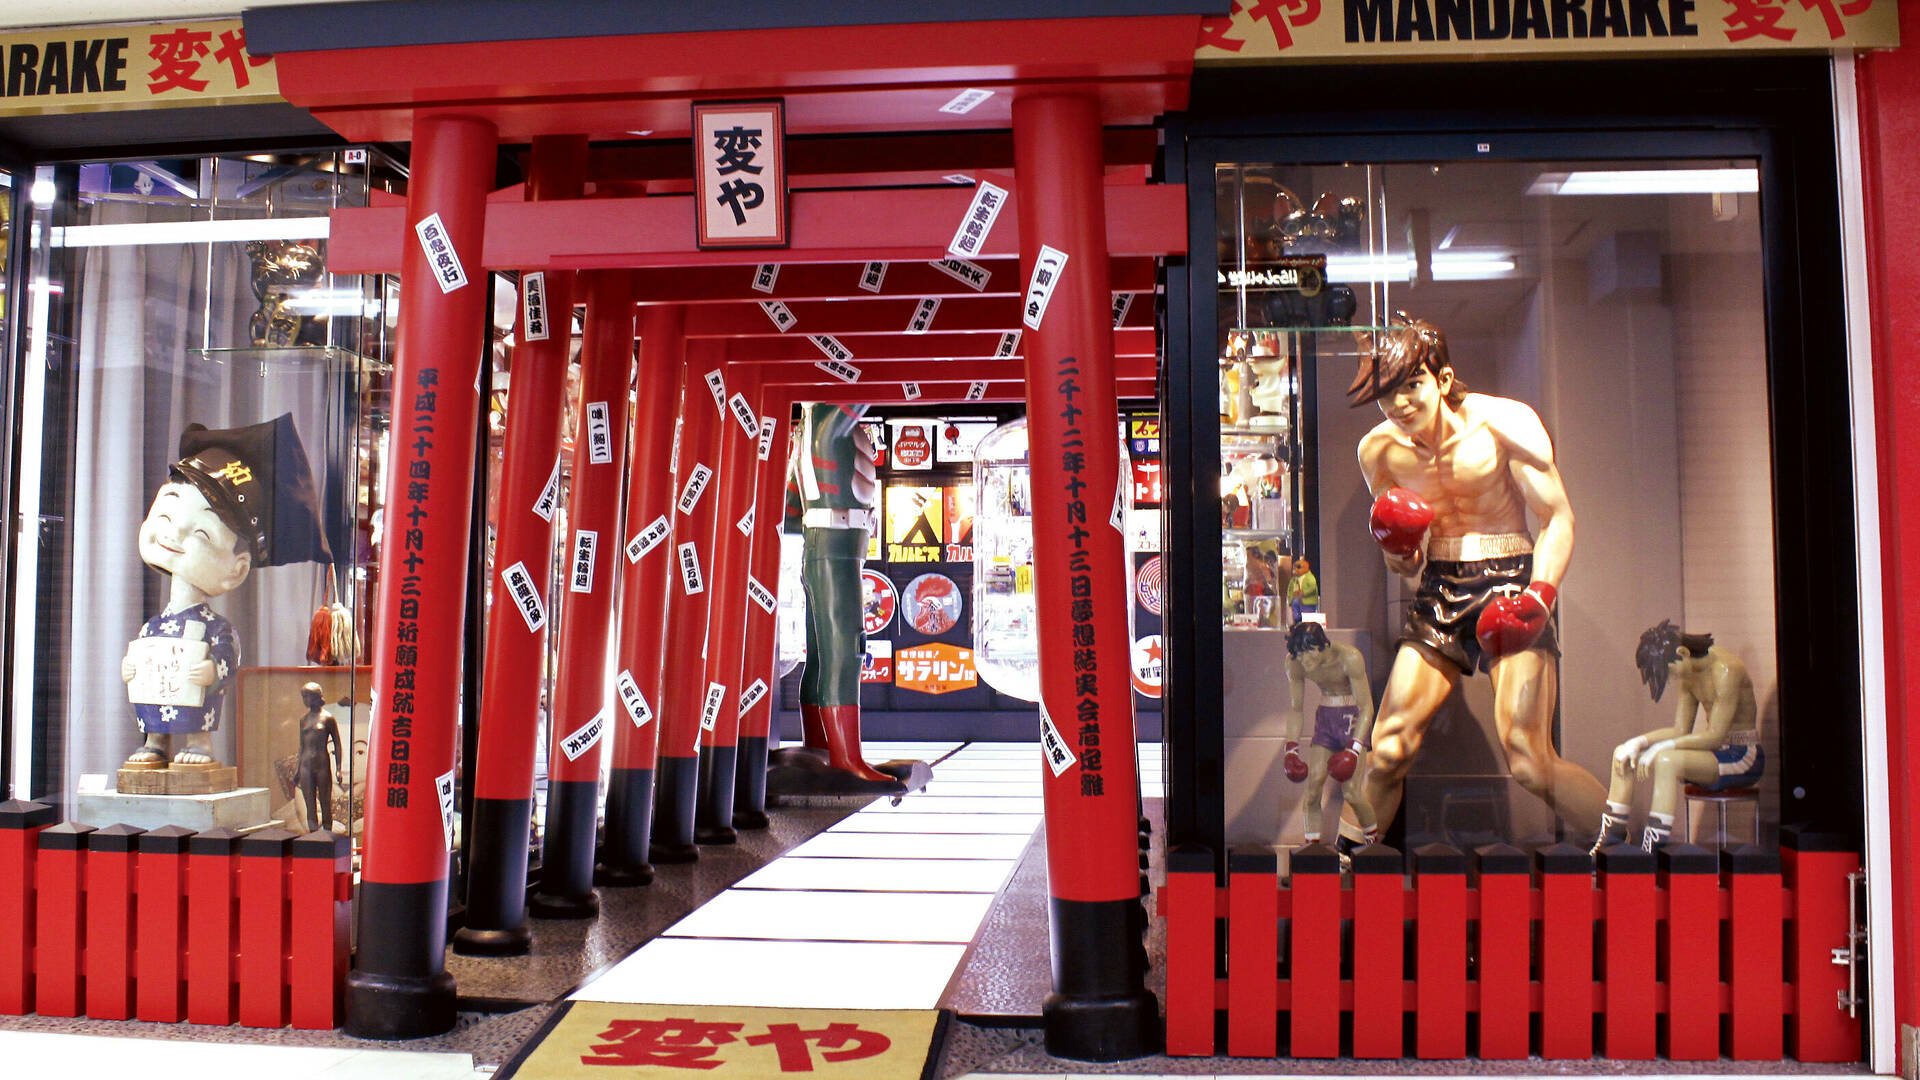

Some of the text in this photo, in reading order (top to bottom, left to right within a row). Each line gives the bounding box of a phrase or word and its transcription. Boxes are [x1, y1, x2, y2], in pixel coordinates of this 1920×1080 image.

[1344, 0, 1698, 43] MANDARAKE
[0, 38, 128, 97] RAKE
[713, 125, 765, 227] 変や
[423, 223, 459, 284] 百鬼夜行
[1027, 258, 1058, 319] 一期一会
[591, 408, 607, 456] 唯一無二
[888, 544, 940, 563] カルピス
[619, 678, 646, 719] 一期一会
[580, 1018, 892, 1073] 変や
